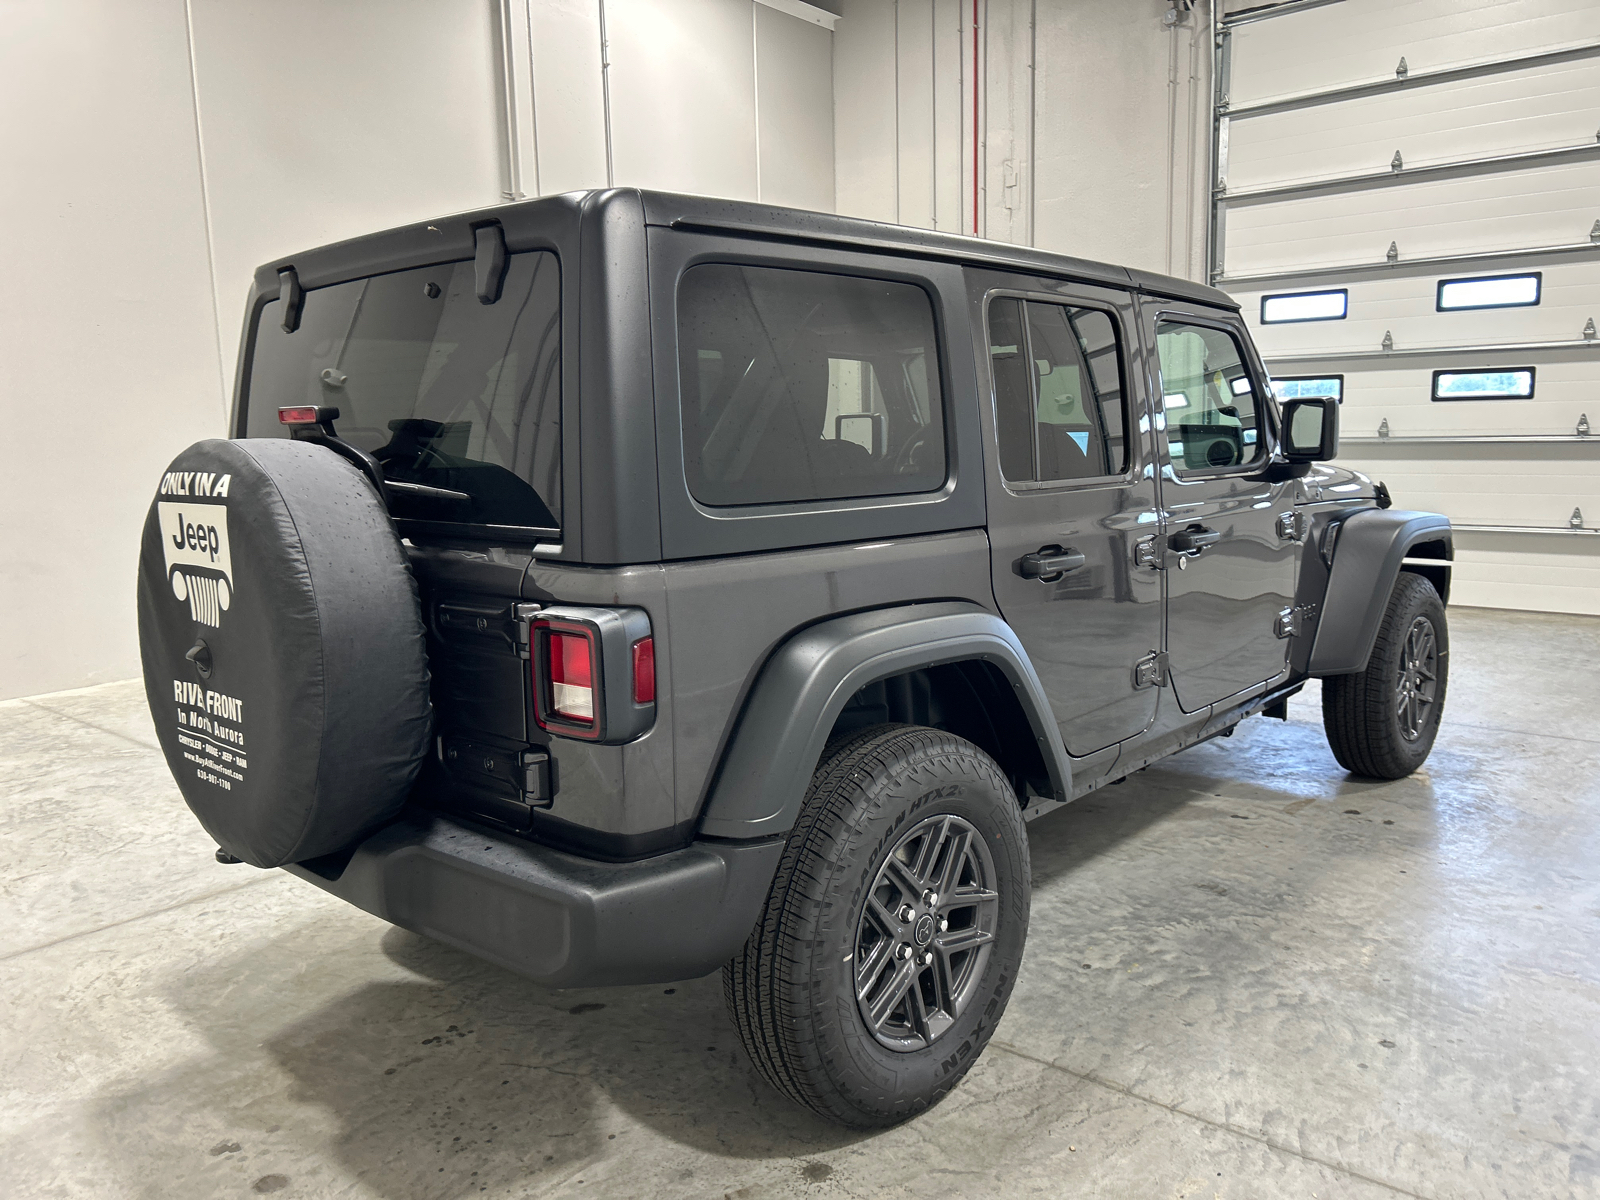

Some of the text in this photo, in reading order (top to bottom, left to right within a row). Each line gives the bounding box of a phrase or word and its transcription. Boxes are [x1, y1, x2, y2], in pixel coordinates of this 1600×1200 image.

[160, 472, 231, 498] ONLY IN A
[172, 513, 219, 563] Jeep
[177, 707, 187, 725] In
[214, 721, 244, 746] Aurora
[940, 973, 1009, 1075] NEXEN
